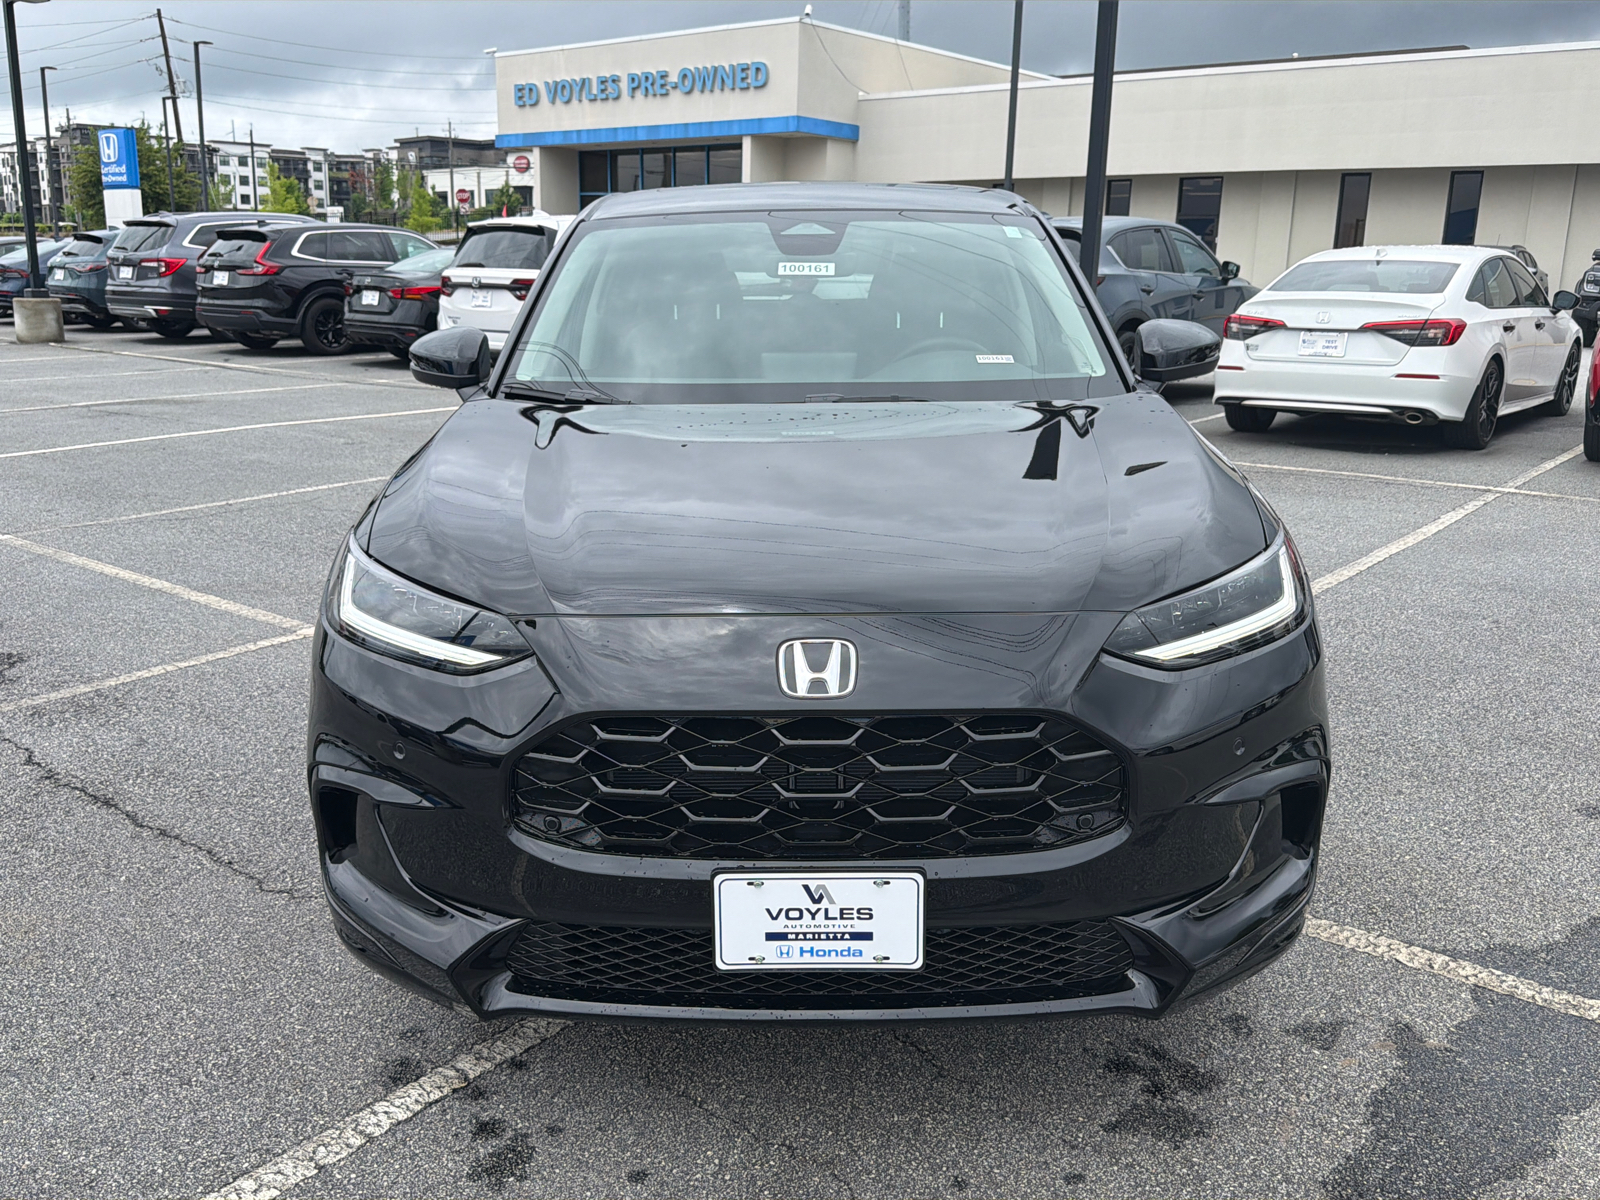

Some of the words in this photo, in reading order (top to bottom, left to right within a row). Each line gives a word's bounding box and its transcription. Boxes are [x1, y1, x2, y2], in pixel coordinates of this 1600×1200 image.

[514, 83, 540, 107] ED
[545, 74, 621, 104] VOYLES
[627, 61, 769, 98] PRE-OWNED
[781, 264, 829, 273] 100161
[765, 908, 874, 921] VOYLES
[799, 946, 863, 958] Honda
